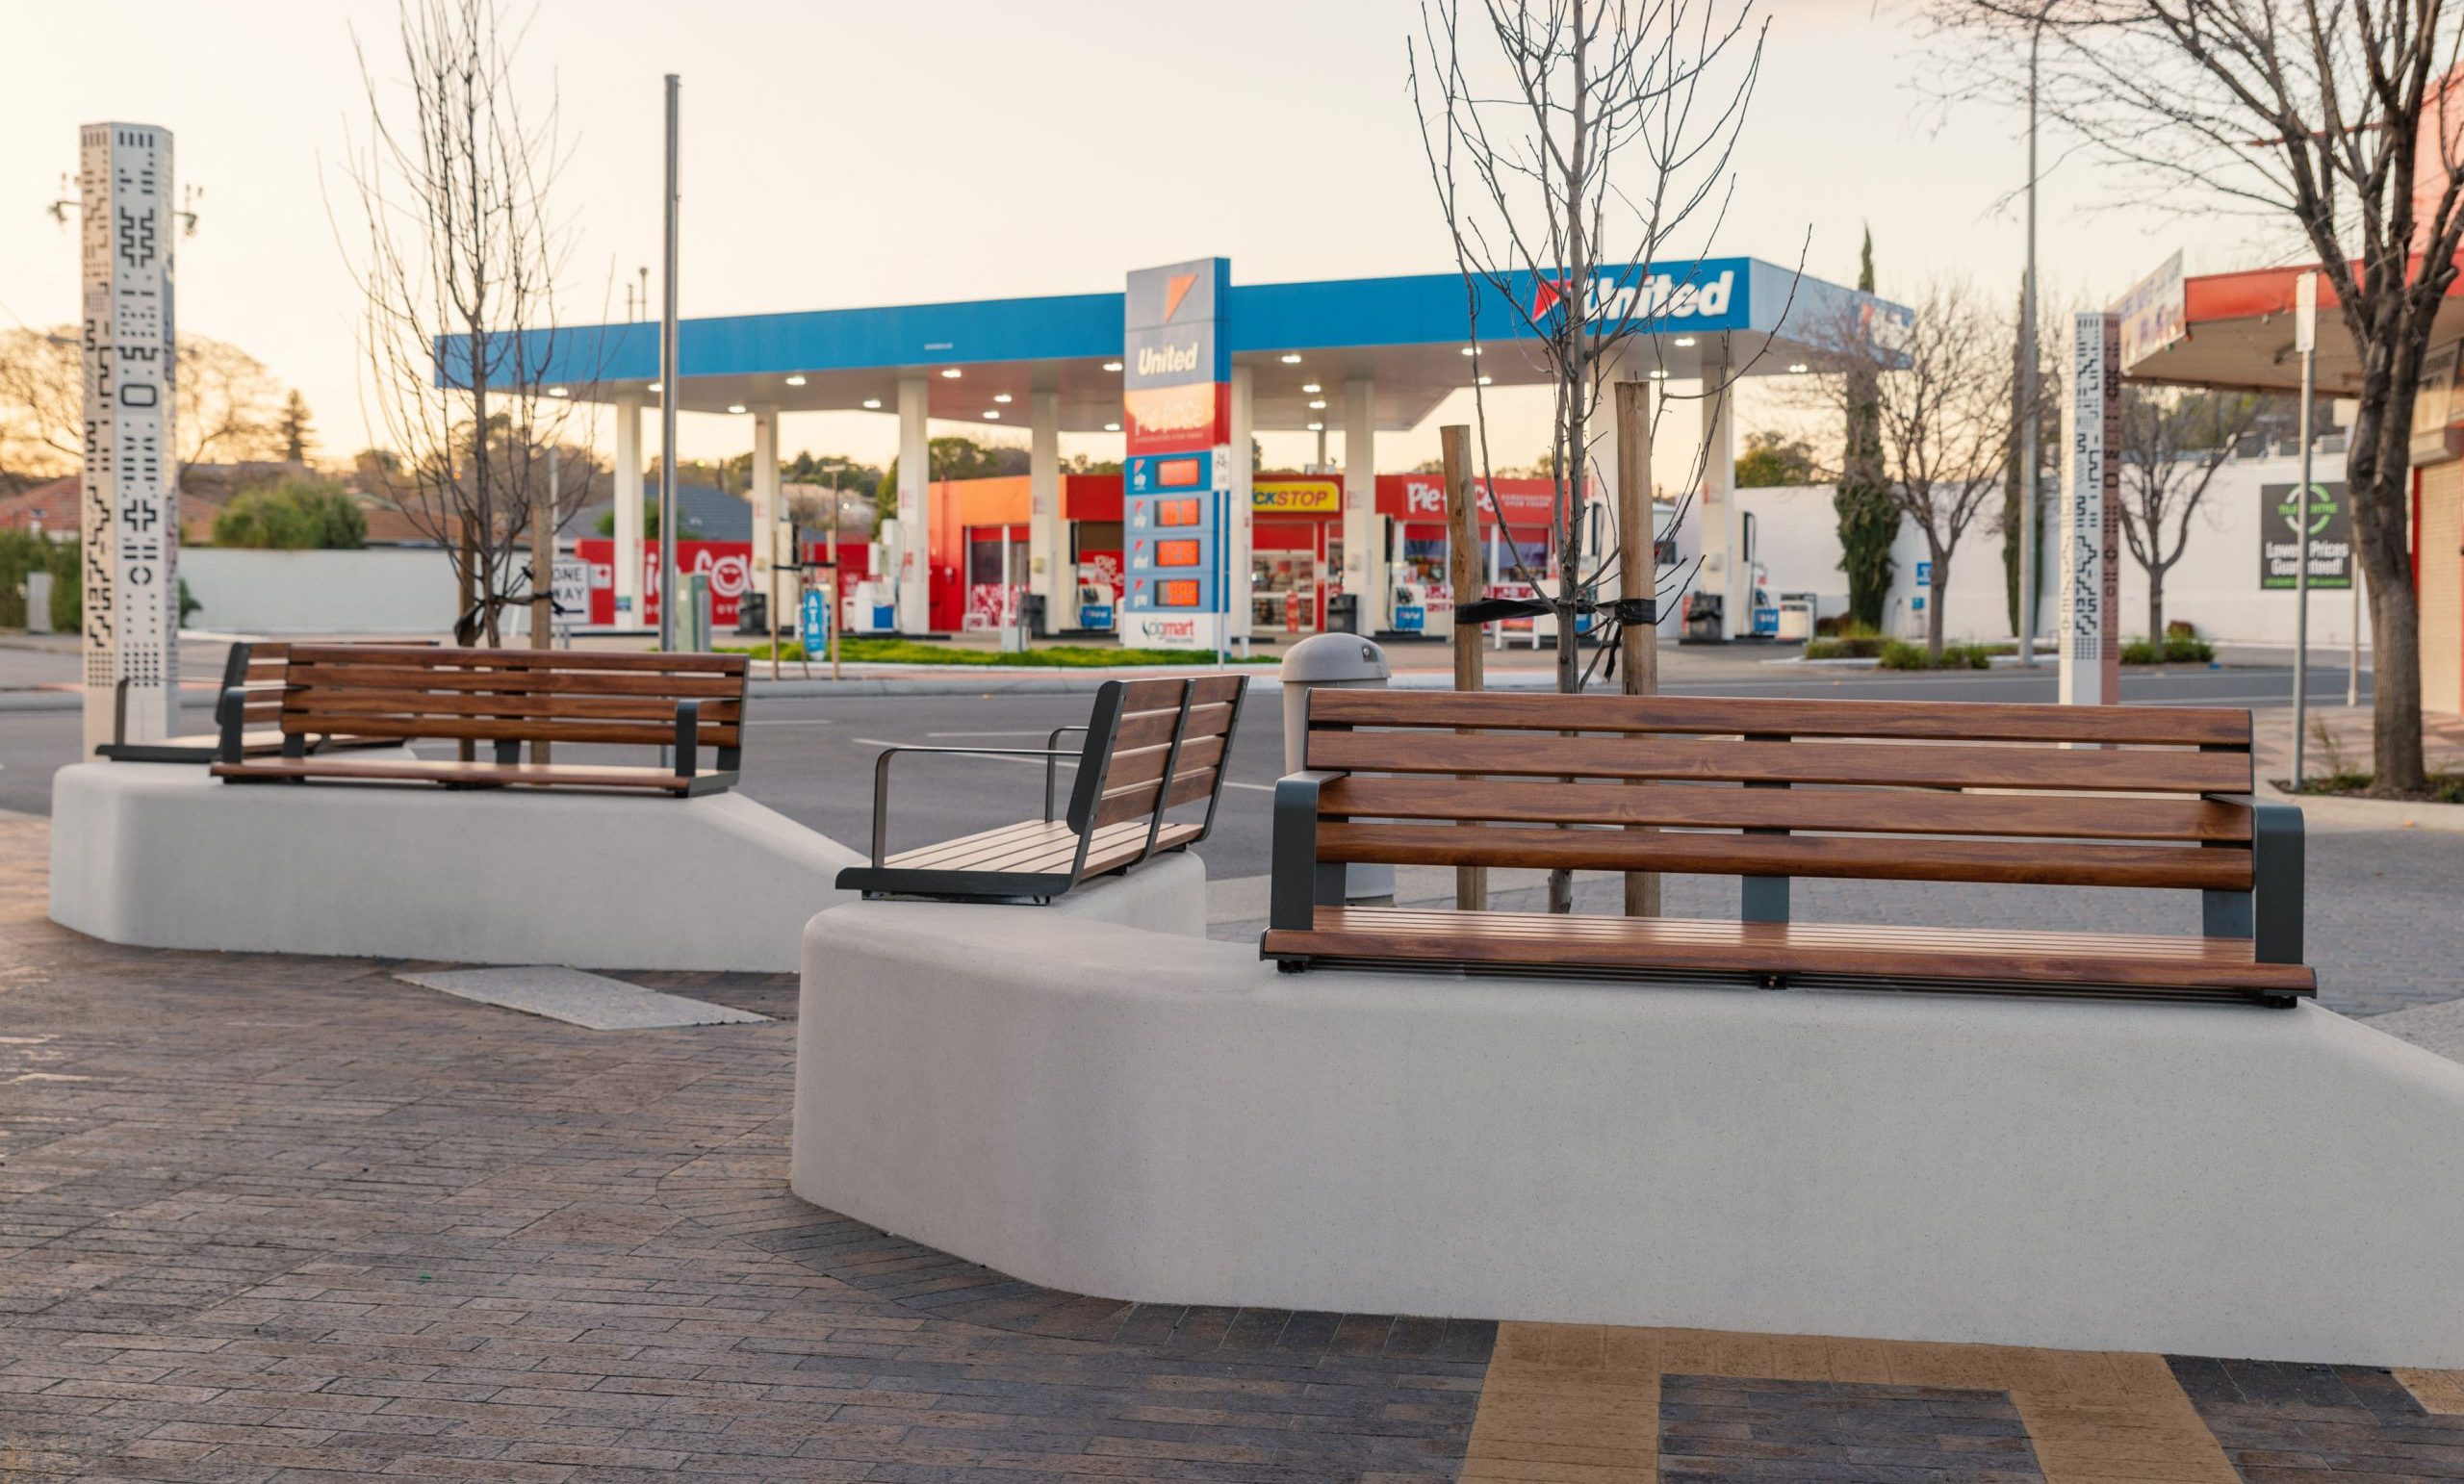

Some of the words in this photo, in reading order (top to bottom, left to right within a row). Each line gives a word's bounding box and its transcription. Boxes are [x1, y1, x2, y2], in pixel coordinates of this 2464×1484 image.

[1582, 270, 1734, 321] United
[1138, 342, 1198, 376] United
[1252, 491, 1327, 507] ICKSTOP
[1407, 483, 1441, 514] Pie
[552, 566, 584, 581] ONE
[694, 549, 755, 598] fa
[808, 595, 820, 635] ATM
